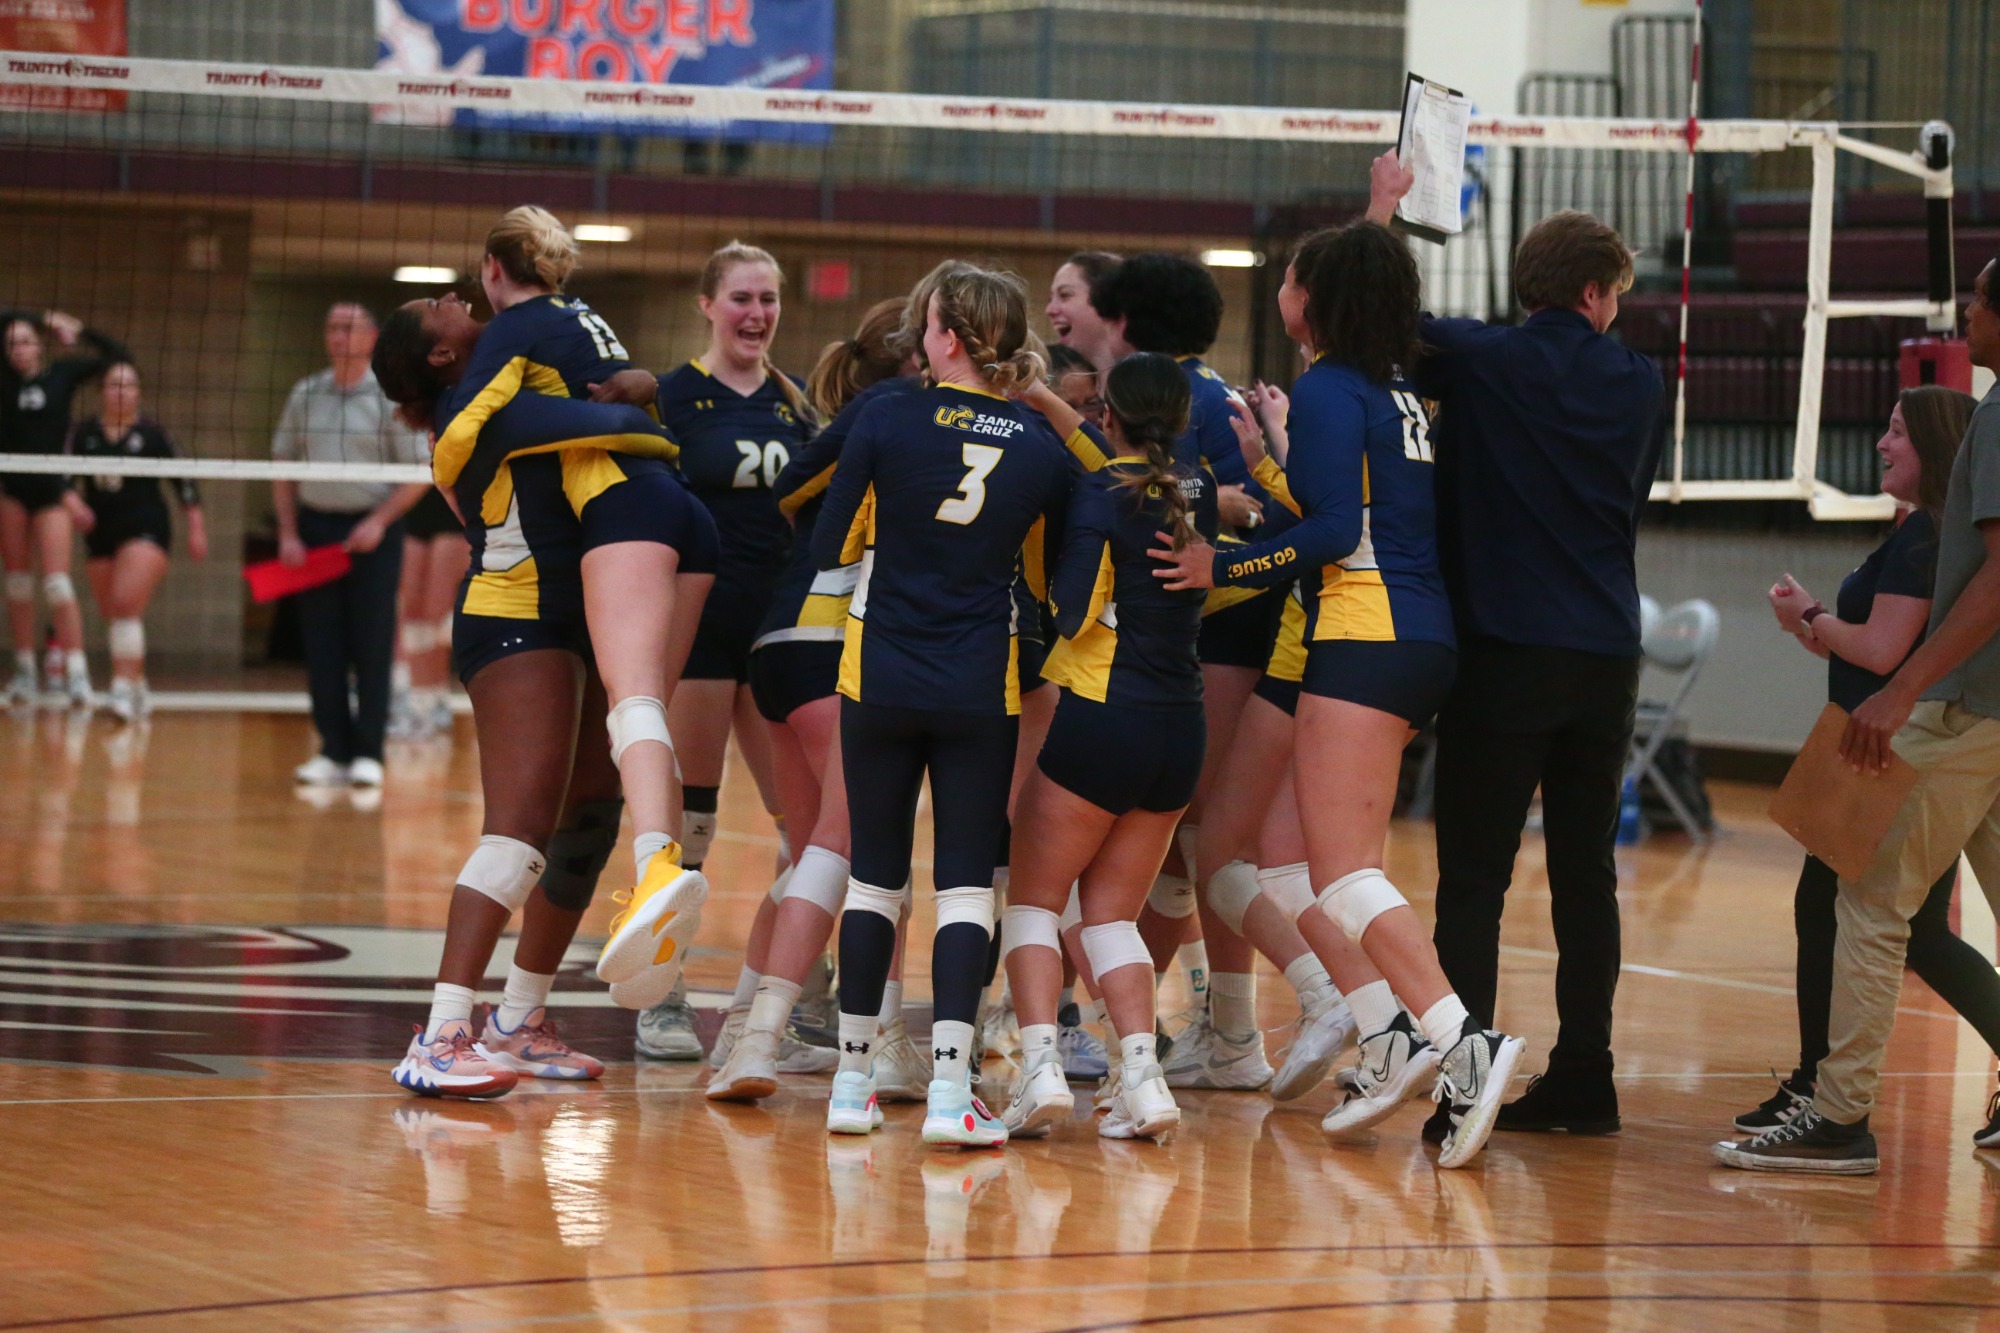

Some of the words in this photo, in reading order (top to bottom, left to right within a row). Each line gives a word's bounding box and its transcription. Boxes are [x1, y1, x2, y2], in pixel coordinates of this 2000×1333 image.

[459, 0, 757, 46] BURGER
[9, 60, 64, 74] TRINITY
[84, 65, 129, 79] TIGERS
[523, 36, 682, 84] BOY
[206, 72, 260, 86] TRINITY
[279, 76, 323, 89] TIGERS
[398, 82, 450, 96] TRINITY
[469, 87, 511, 99] TIGERS
[585, 91, 635, 104] TRINITY
[972, 423, 1013, 438] CRUZ
[975, 413, 1024, 432] SANTA
[732, 440, 790, 488] 20
[934, 442, 1004, 526] 3
[1182, 488, 1201, 499] RUZ
[1274, 546, 1297, 566] GO
